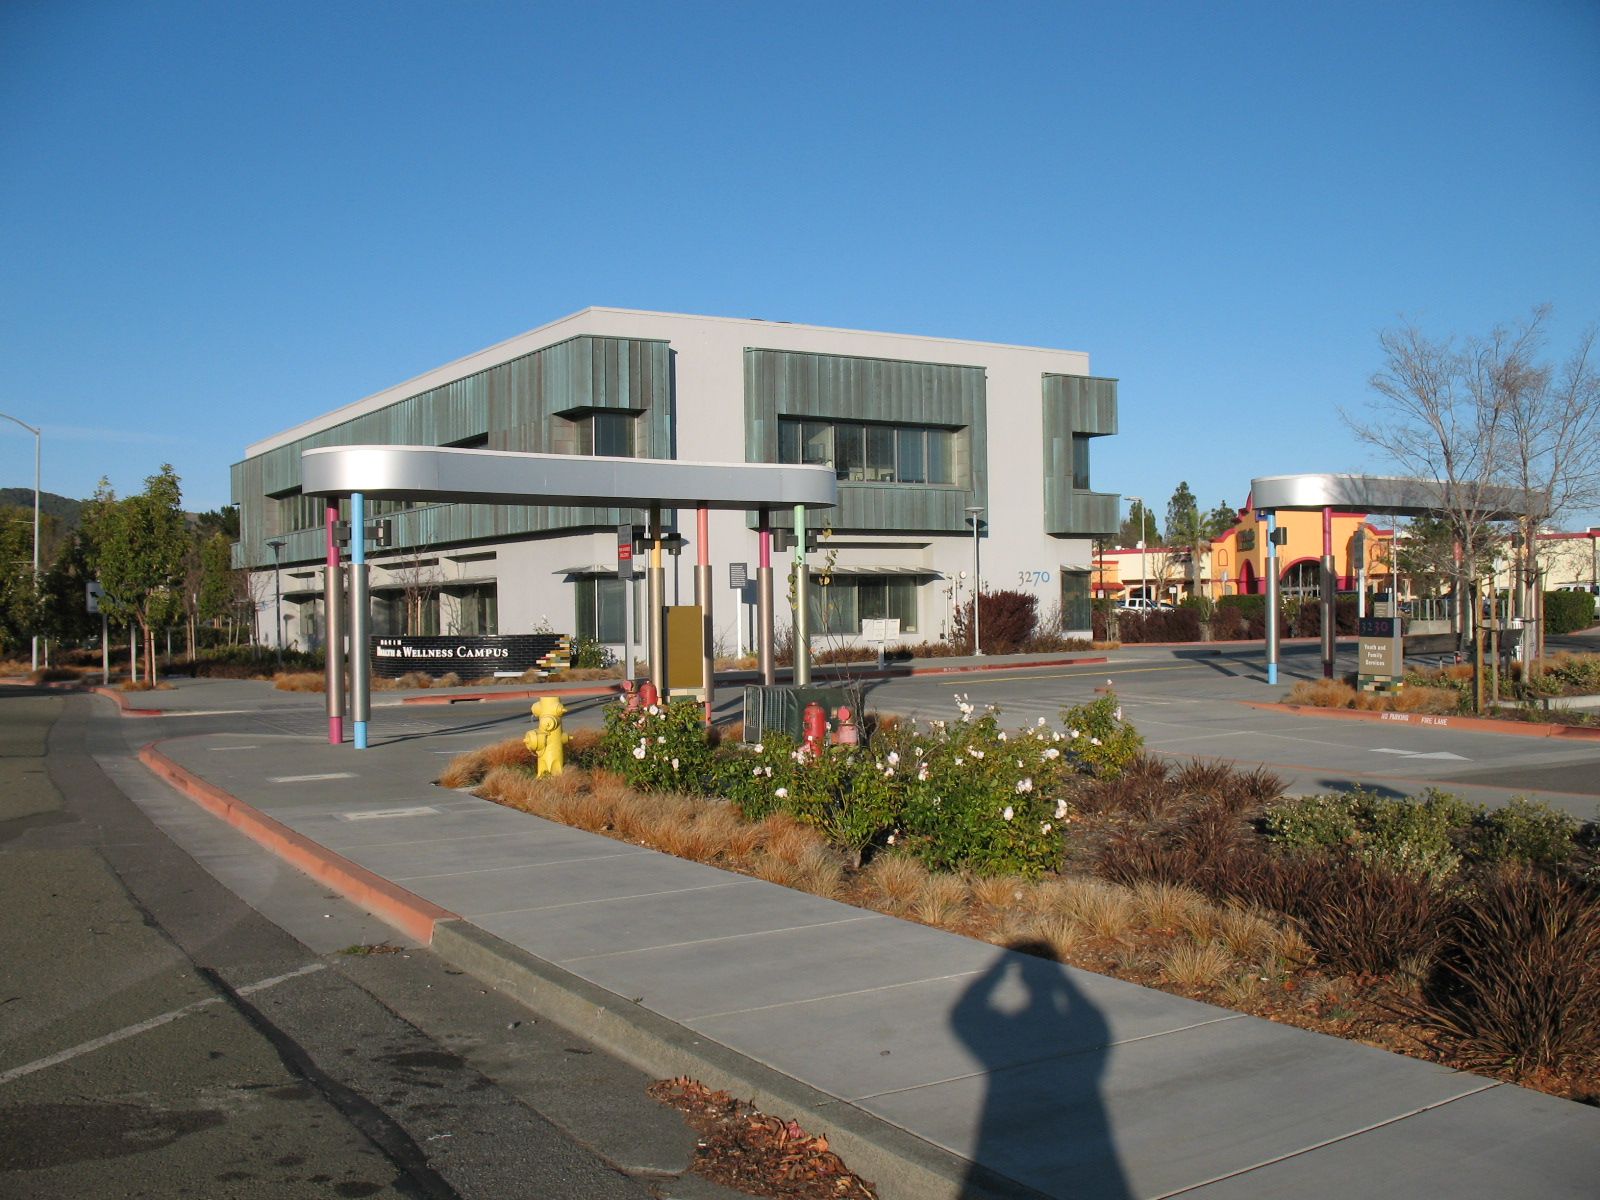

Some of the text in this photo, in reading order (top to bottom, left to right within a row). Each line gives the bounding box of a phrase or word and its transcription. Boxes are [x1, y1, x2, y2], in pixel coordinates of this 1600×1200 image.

[1018, 571, 1050, 587] 3270
[1361, 621, 1389, 635] 3230
[396, 648, 402, 658] &
[402, 646, 454, 658] WELLNESS
[456, 645, 509, 658] CAMPUS
[1364, 643, 1377, 651] Youth
[1367, 651, 1383, 660] Family
[1389, 713, 1409, 721] PARKING
[1421, 716, 1448, 726] FIRE LANE
